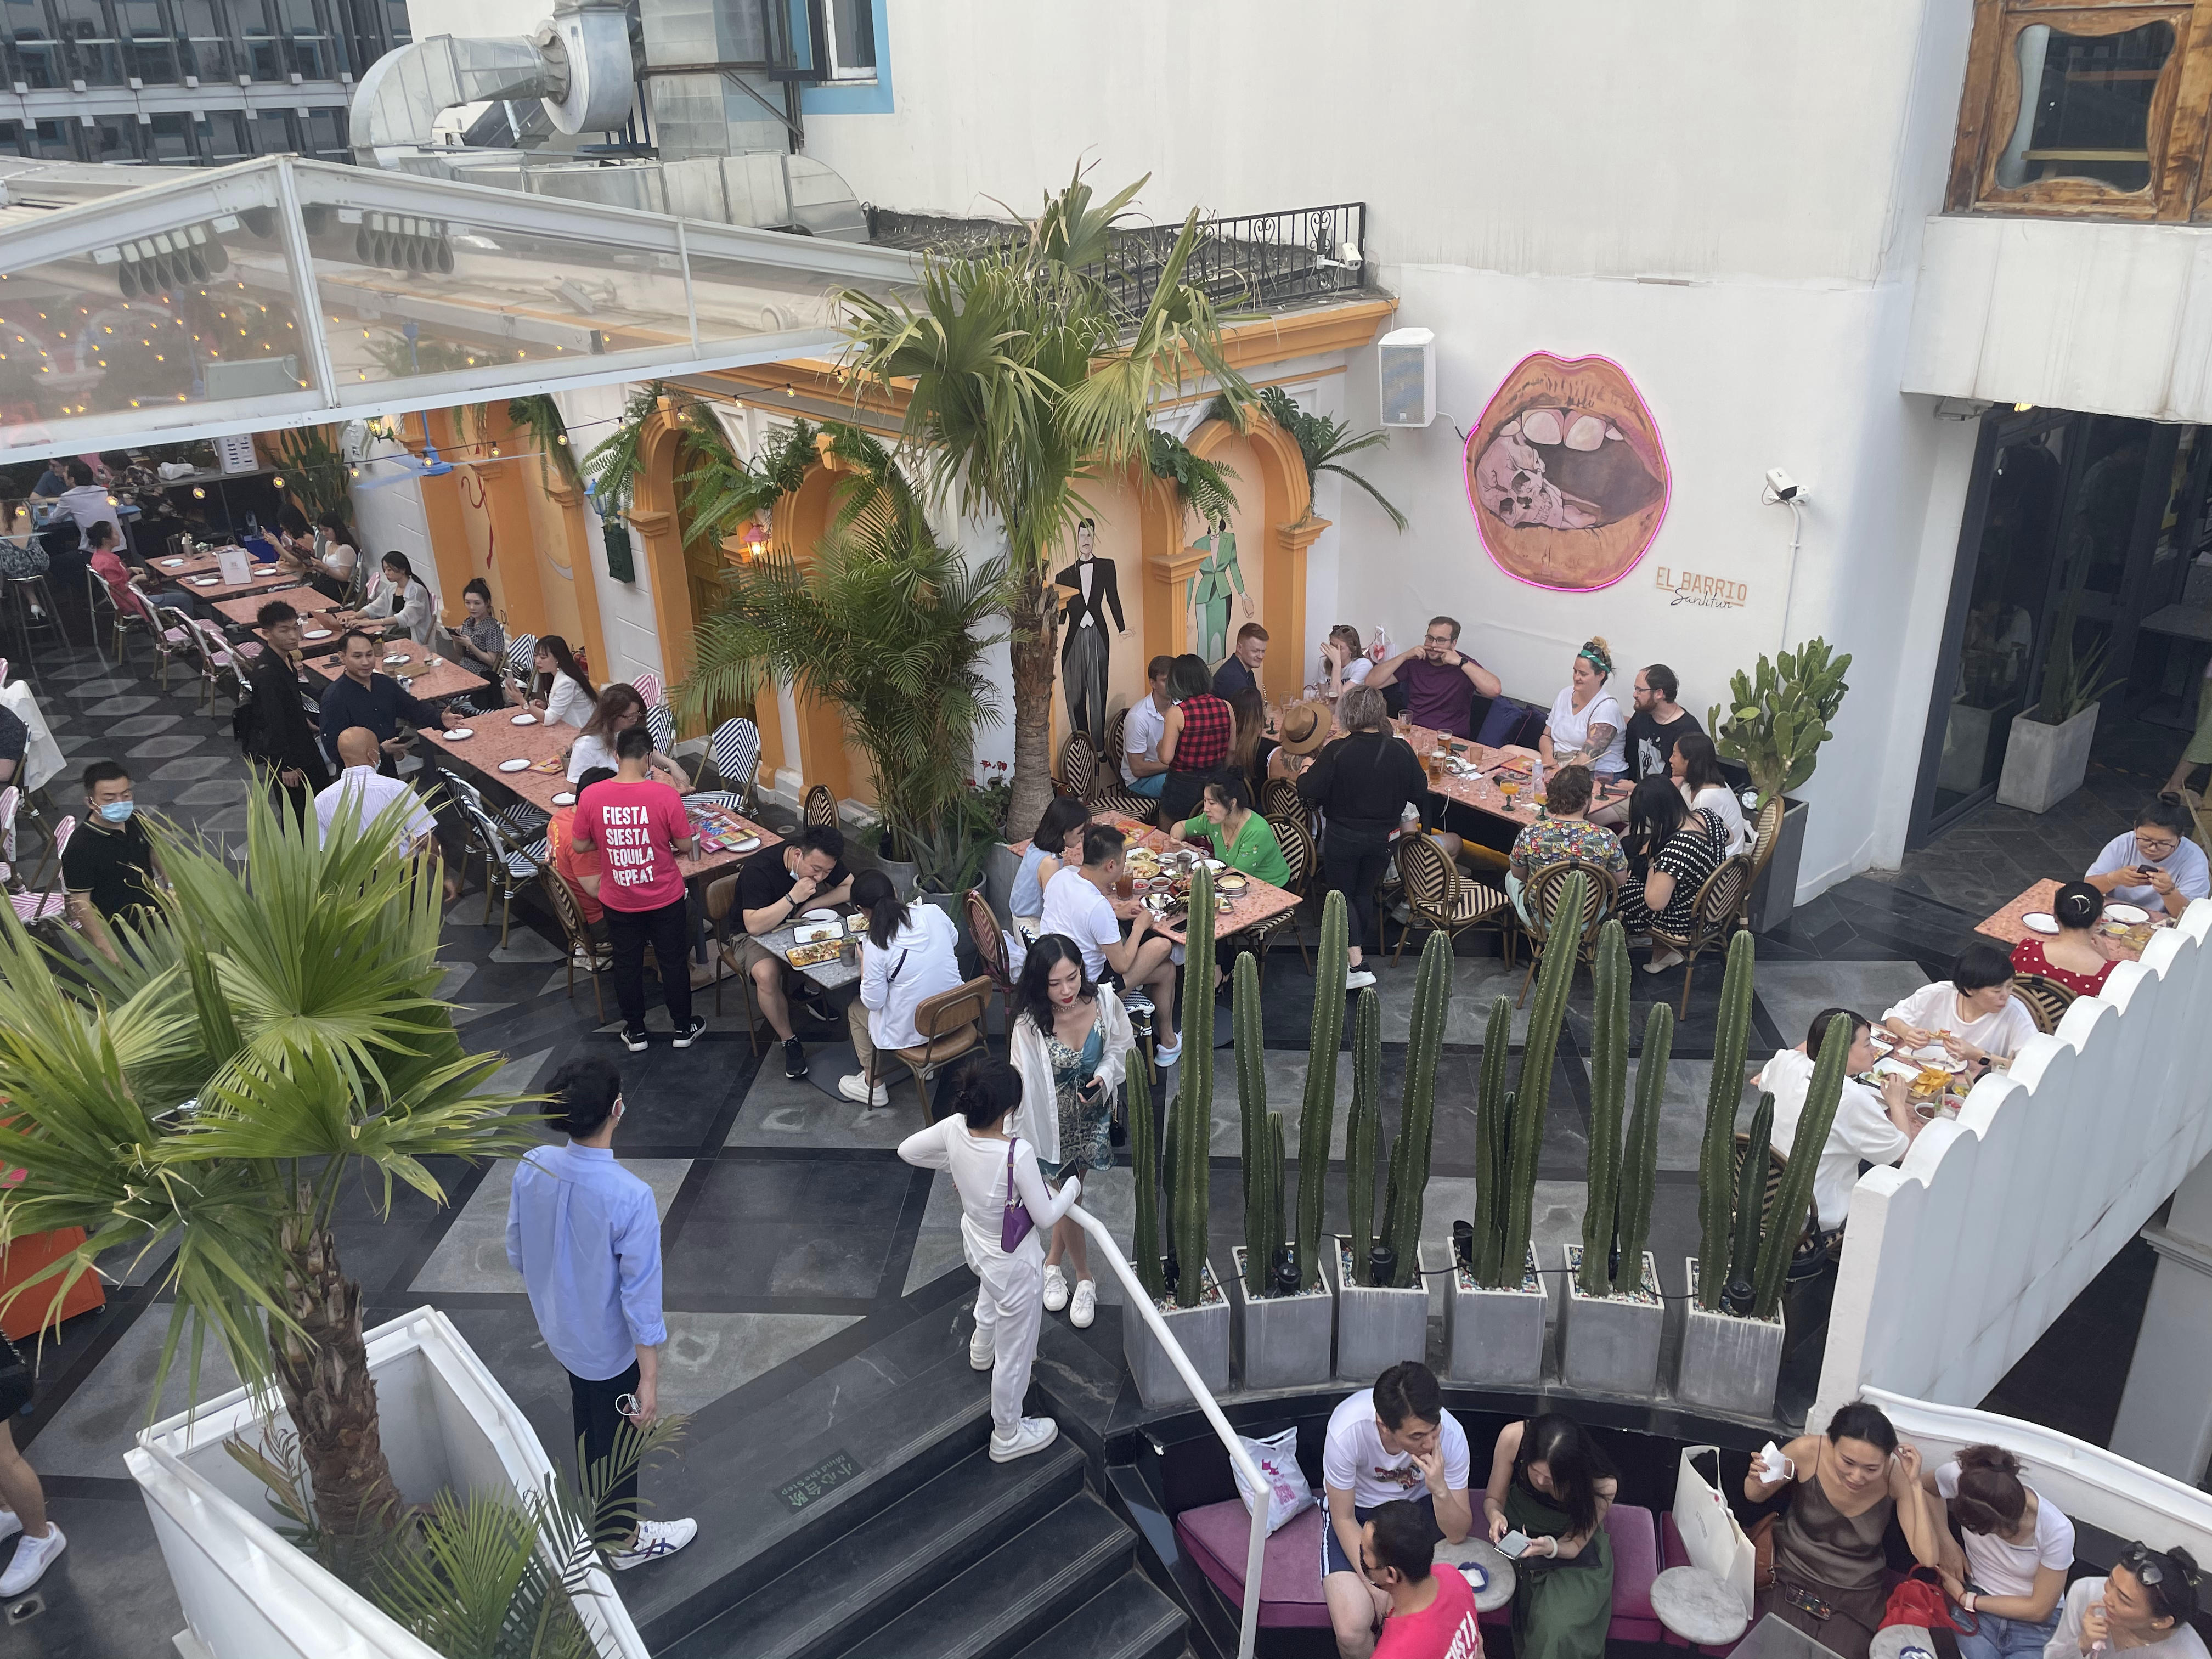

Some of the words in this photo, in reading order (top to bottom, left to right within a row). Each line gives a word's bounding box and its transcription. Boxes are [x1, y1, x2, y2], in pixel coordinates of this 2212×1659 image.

[1656, 566, 1674, 588] EL
[1681, 571, 1747, 601] BARRIO
[1670, 588, 1733, 608] Sanlitun
[603, 806, 649, 825] FIESTA
[605, 828, 651, 846] SIESTA
[606, 847, 655, 867] TEQUILA
[612, 865, 654, 887] REPEAT
[821, 1455, 845, 1472] Mind
[788, 1463, 852, 1506] 小心台阶
[804, 1470, 821, 1481] the
[781, 1480, 804, 1495] Step
